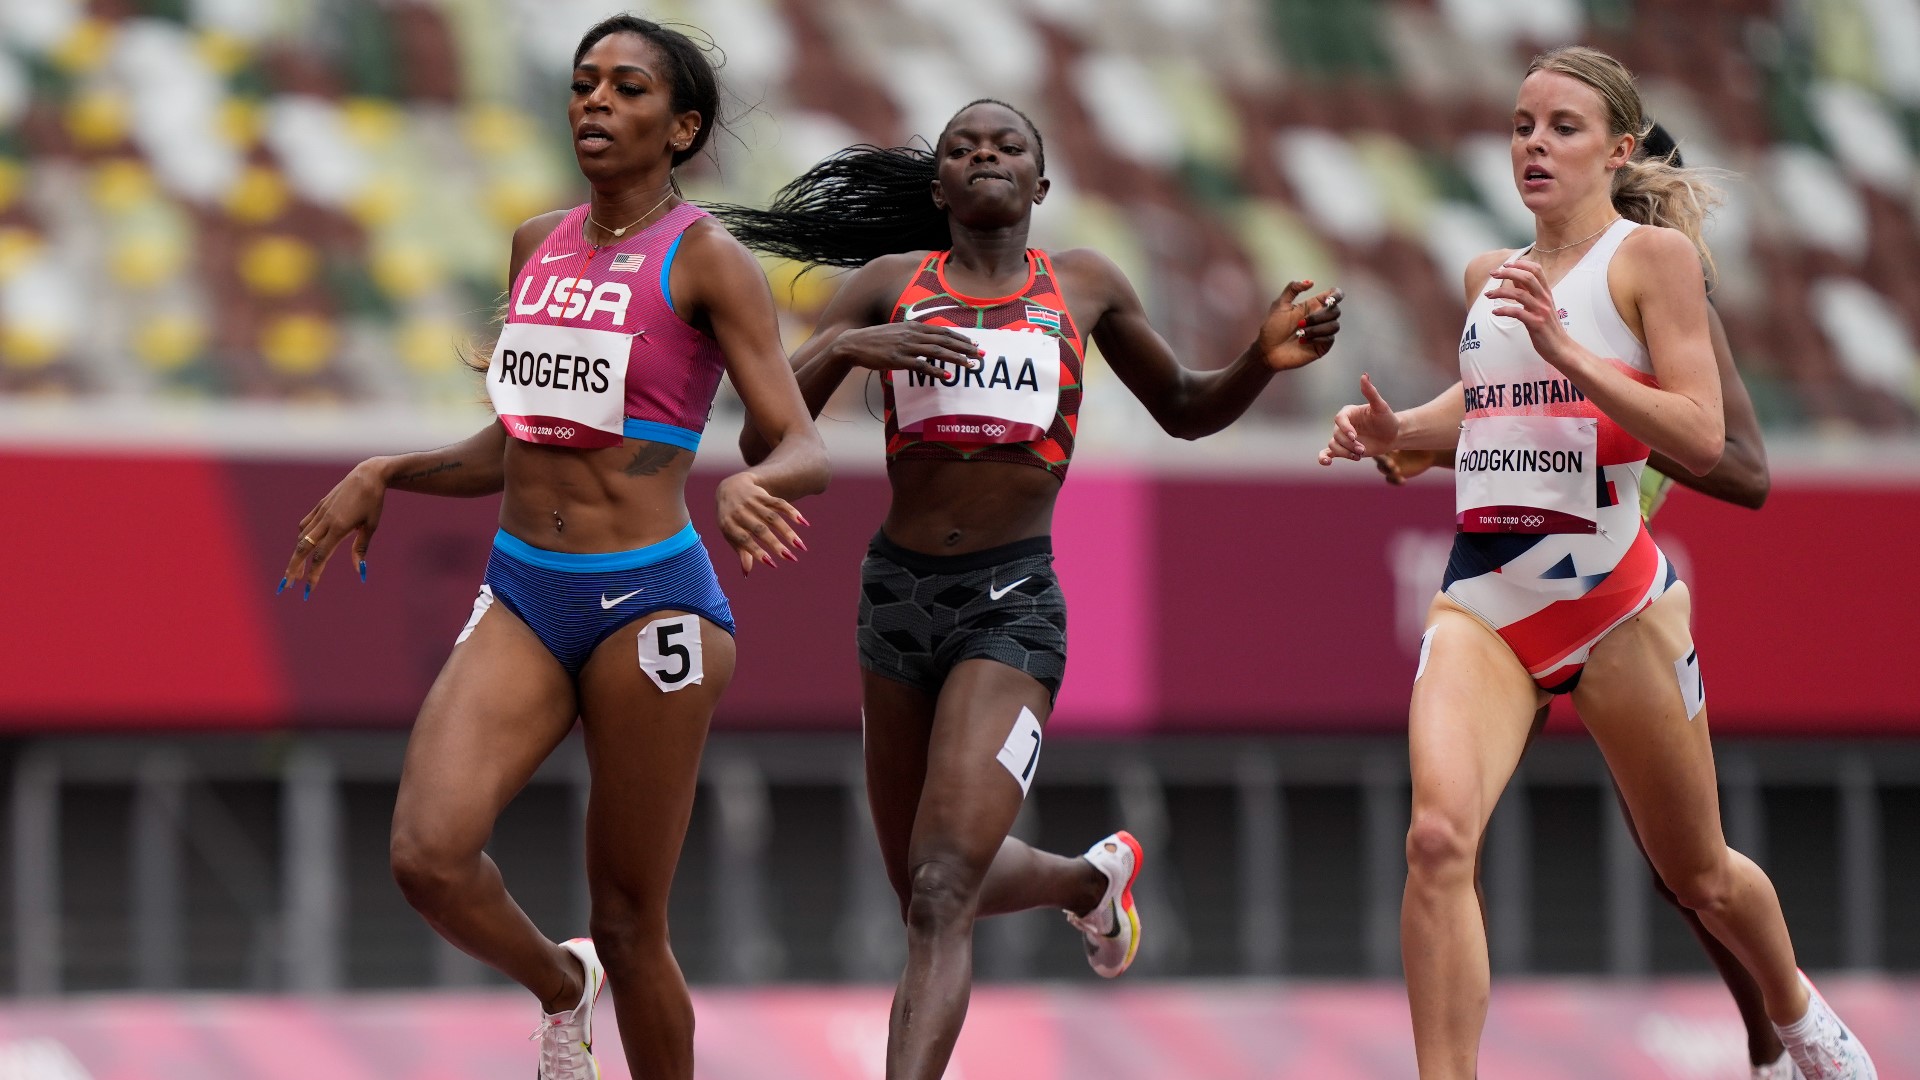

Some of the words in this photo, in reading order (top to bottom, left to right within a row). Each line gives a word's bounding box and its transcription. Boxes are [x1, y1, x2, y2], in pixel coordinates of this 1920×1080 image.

[514, 275, 632, 325] USA
[499, 349, 611, 394] ROGERS
[1464, 383, 1506, 413] GREAT
[514, 422, 537, 435] TOKYO
[537, 425, 553, 436] 2020
[937, 424, 959, 433] TOKYO
[960, 424, 980, 433] 2020
[1459, 449, 1583, 473] HODGKINSON
[1479, 516, 1502, 524] TOKYO
[1502, 516, 1519, 525] 2020
[655, 622, 691, 684] 5
